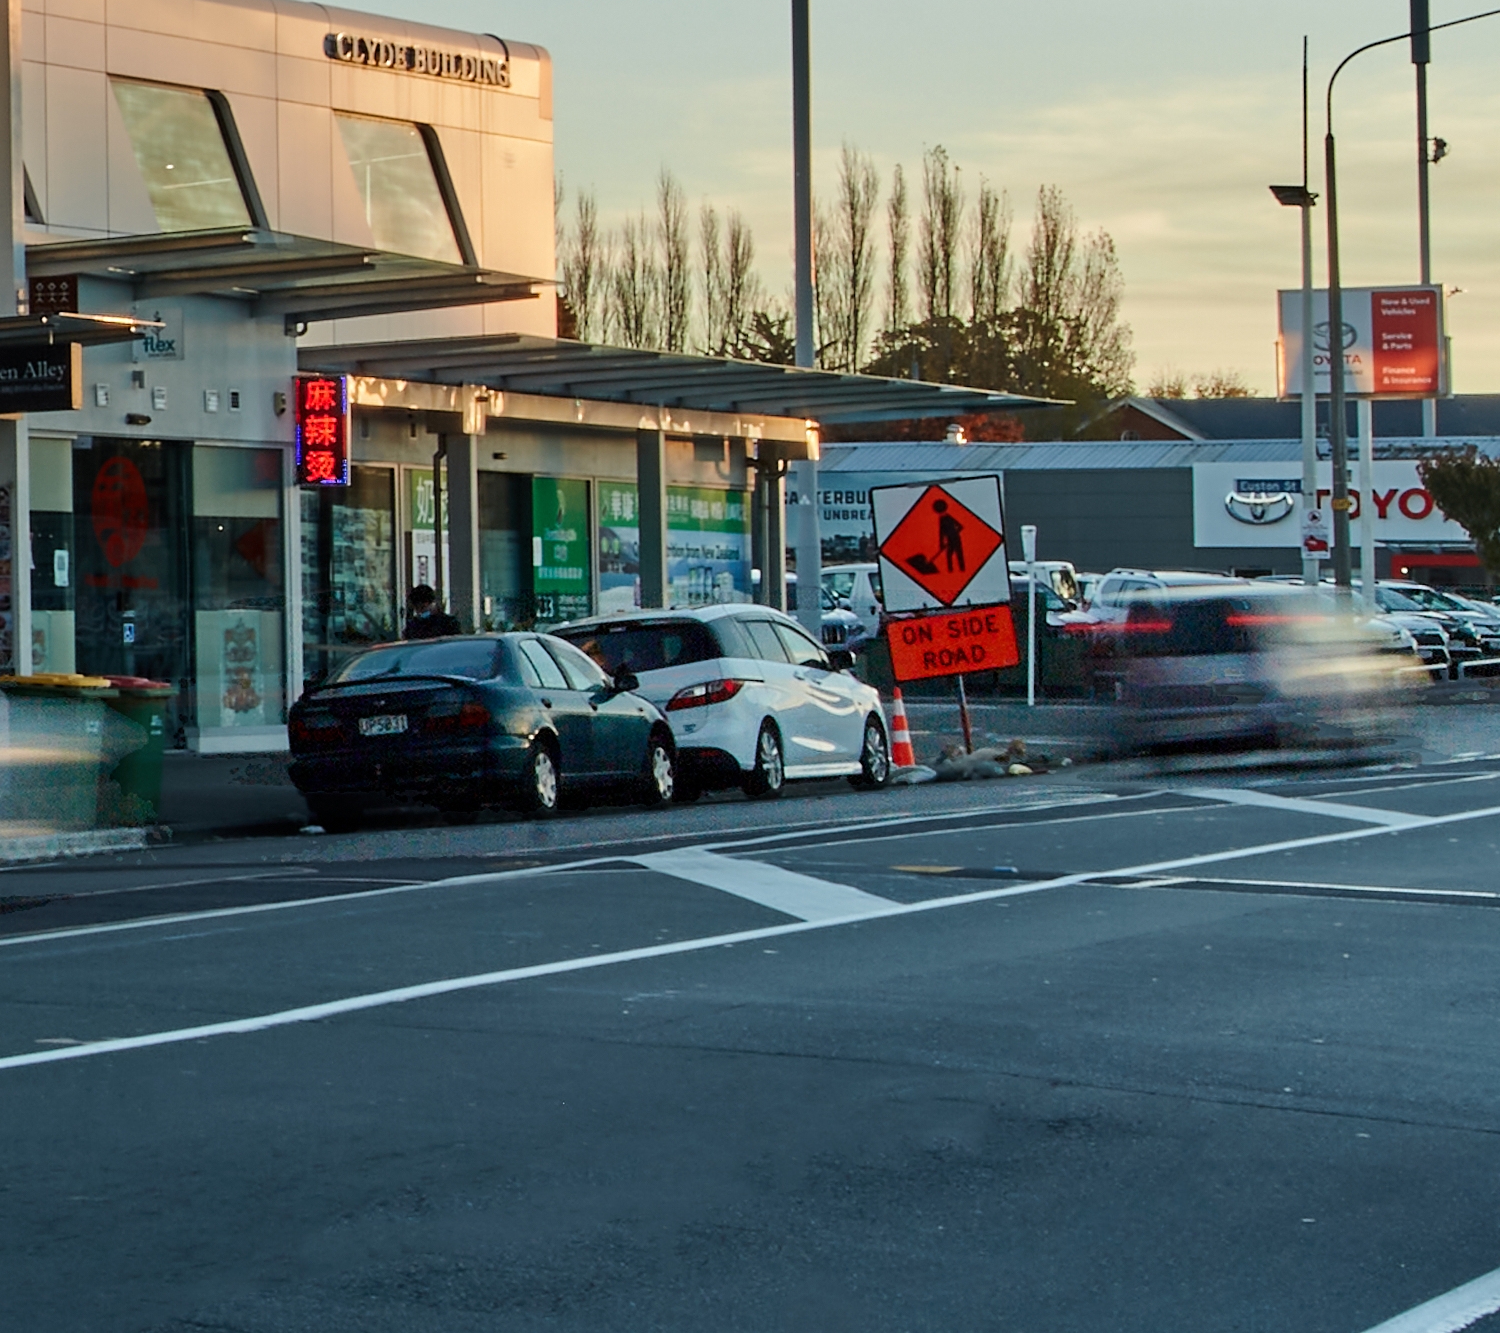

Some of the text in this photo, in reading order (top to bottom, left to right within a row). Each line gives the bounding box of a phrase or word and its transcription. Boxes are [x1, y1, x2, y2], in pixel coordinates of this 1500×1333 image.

[336, 32, 511, 87] CLYDE BUILDING
[1409, 297, 1430, 305] Used
[1381, 308, 1416, 316] Vehicles
[1381, 333, 1413, 341] Service
[143, 336, 176, 353] flex
[1390, 342, 1413, 350] Parts
[23, 360, 67, 381] Alley
[1382, 366, 1416, 374] Finance
[304, 378, 338, 483] 麻辣烫
[1240, 481, 1297, 492] Euston St
[902, 614, 999, 646] ON SIDE
[922, 644, 987, 671] ROAD
